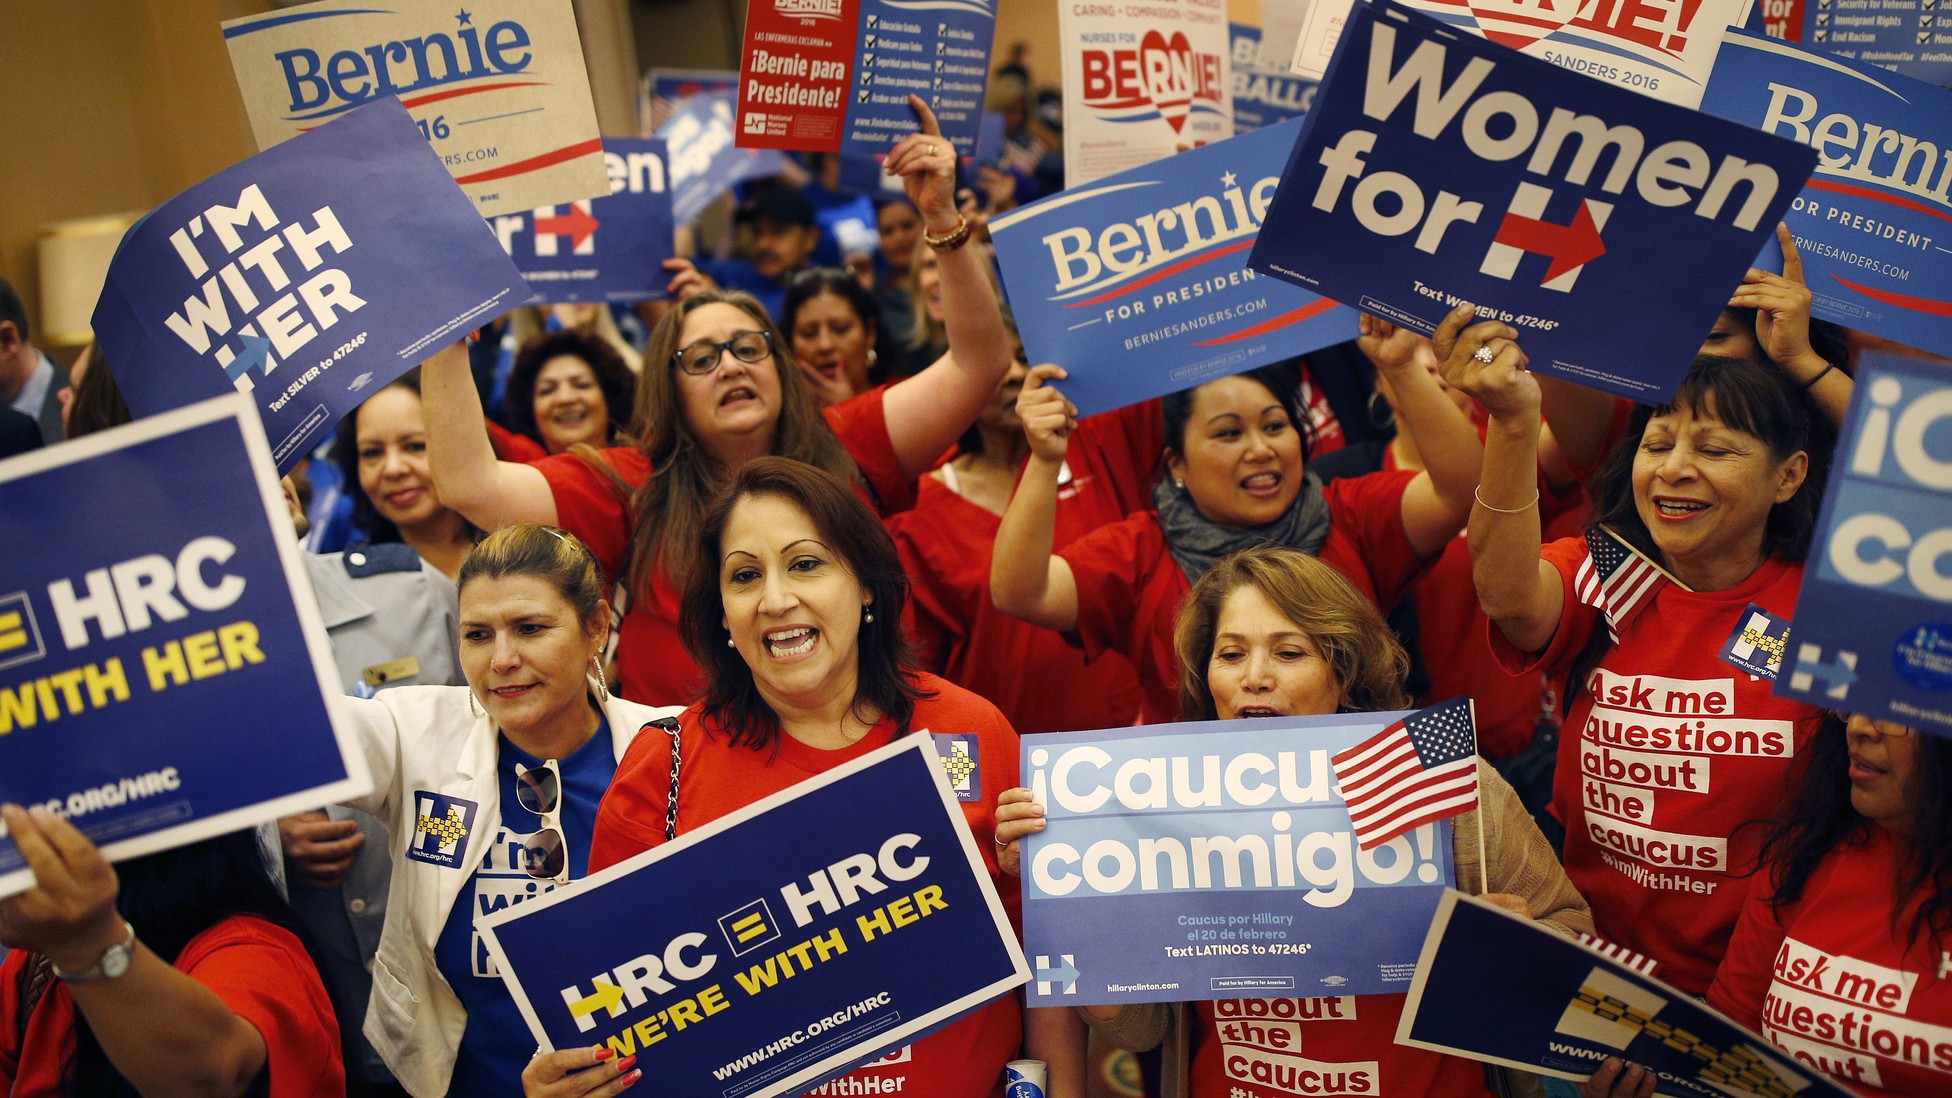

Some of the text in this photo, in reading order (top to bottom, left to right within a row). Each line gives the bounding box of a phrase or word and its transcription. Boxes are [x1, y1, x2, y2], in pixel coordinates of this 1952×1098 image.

[800, 18, 816, 26] 2016
[1073, 4, 1116, 17] CARING
[1834, 14, 1902, 28] Immigrant Rights
[1936, 16, 1952, 28] Exp
[754, 32, 764, 41] LAS
[1080, 33, 1137, 43] NURSES FOR
[1832, 31, 1876, 43] End Racism
[1934, 34, 1952, 44] Mon
[275, 8, 532, 112] Bernie
[751, 49, 846, 81] ¡Bernie para
[1543, 51, 1660, 91] SANDERS 2016
[747, 79, 841, 108] Presidente!
[417, 115, 450, 141] 16
[766, 128, 787, 136] United
[767, 113, 793, 122] National
[767, 121, 787, 129] Nurses
[1362, 20, 1780, 233] Women
[1761, 82, 1952, 208] Bern
[1311, 129, 1484, 255] for
[169, 183, 280, 280] I'M
[1042, 169, 1281, 292] Bernie
[1791, 197, 1932, 251] OR PRESIDENT
[1269, 263, 1320, 286] hillaryclinton.com
[1792, 234, 1910, 281] RNIESANDERS.COM
[164, 205, 354, 355] WITH
[1105, 268, 1258, 324] FOR PRESIDEN
[1367, 300, 1382, 312] Paid
[1397, 312, 1416, 325] Hillary
[1413, 281, 1444, 302] Text
[1499, 310, 1514, 323] to
[214, 268, 367, 396] HER
[1125, 299, 1268, 350] BERNIESANDERS.COM
[269, 392, 291, 413] Text
[287, 366, 322, 396] SILVER
[320, 358, 333, 370] to
[48, 535, 247, 651] HRC
[0, 620, 266, 737] WITH HER
[1590, 672, 1727, 715] Ask me
[1586, 714, 1785, 756] questions
[1583, 748, 1697, 790] about
[1586, 781, 1644, 819] the
[1032, 811, 1439, 908] conmigo!
[1590, 823, 1719, 868] caucus
[1601, 849, 1717, 895] #ImWithHer
[561, 832, 931, 1033] HRC HRC
[733, 927, 849, 996] WITH
[856, 884, 949, 944] HER
[1177, 913, 1293, 927] Caucus por Hillary
[1187, 928, 1287, 941] el 20 de febrero
[1165, 945, 1194, 957] Text
[1196, 944, 1249, 956] LATINOS
[1252, 944, 1266, 955] to
[1107, 980, 1179, 993] hillaryclinton.com
[1244, 979, 1260, 987] Hillary
[1774, 943, 1902, 1009] Ask me
[1216, 995, 1344, 1019] about
[712, 991, 892, 1081] WWW.HRC.ORG/HRC
[1222, 1021, 1291, 1049] the
[1763, 992, 1952, 1072] questions
[810, 1075, 906, 1096] WithHer
[1227, 1054, 1371, 1094] caucus
